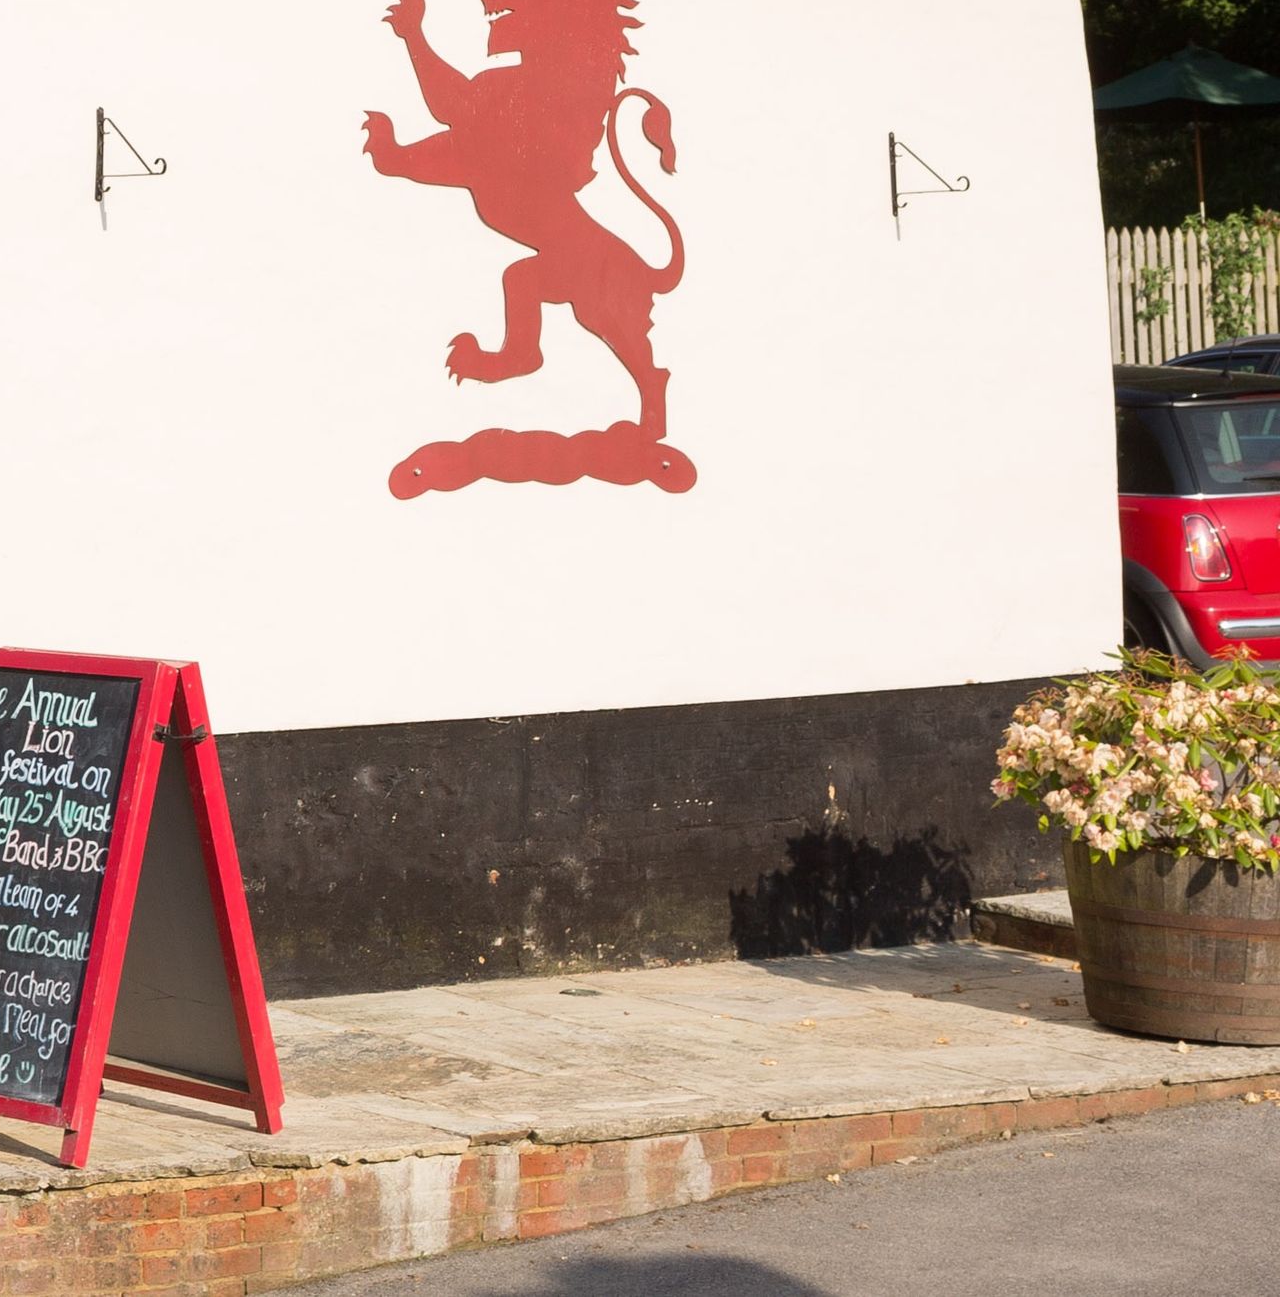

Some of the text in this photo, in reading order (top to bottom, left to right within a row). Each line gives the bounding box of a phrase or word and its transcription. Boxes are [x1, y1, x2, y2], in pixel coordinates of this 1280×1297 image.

[11, 677, 98, 728] Annual
[22, 720, 75, 759] Lion
[82, 766, 111, 798] on
[43, 789, 111, 838] August
[2, 829, 50, 870] Band
[44, 893, 66, 918] of
[64, 894, 80, 917] 4
[4, 971, 19, 997] a
[19, 970, 71, 1007] chance
[38, 1018, 77, 1060] for
